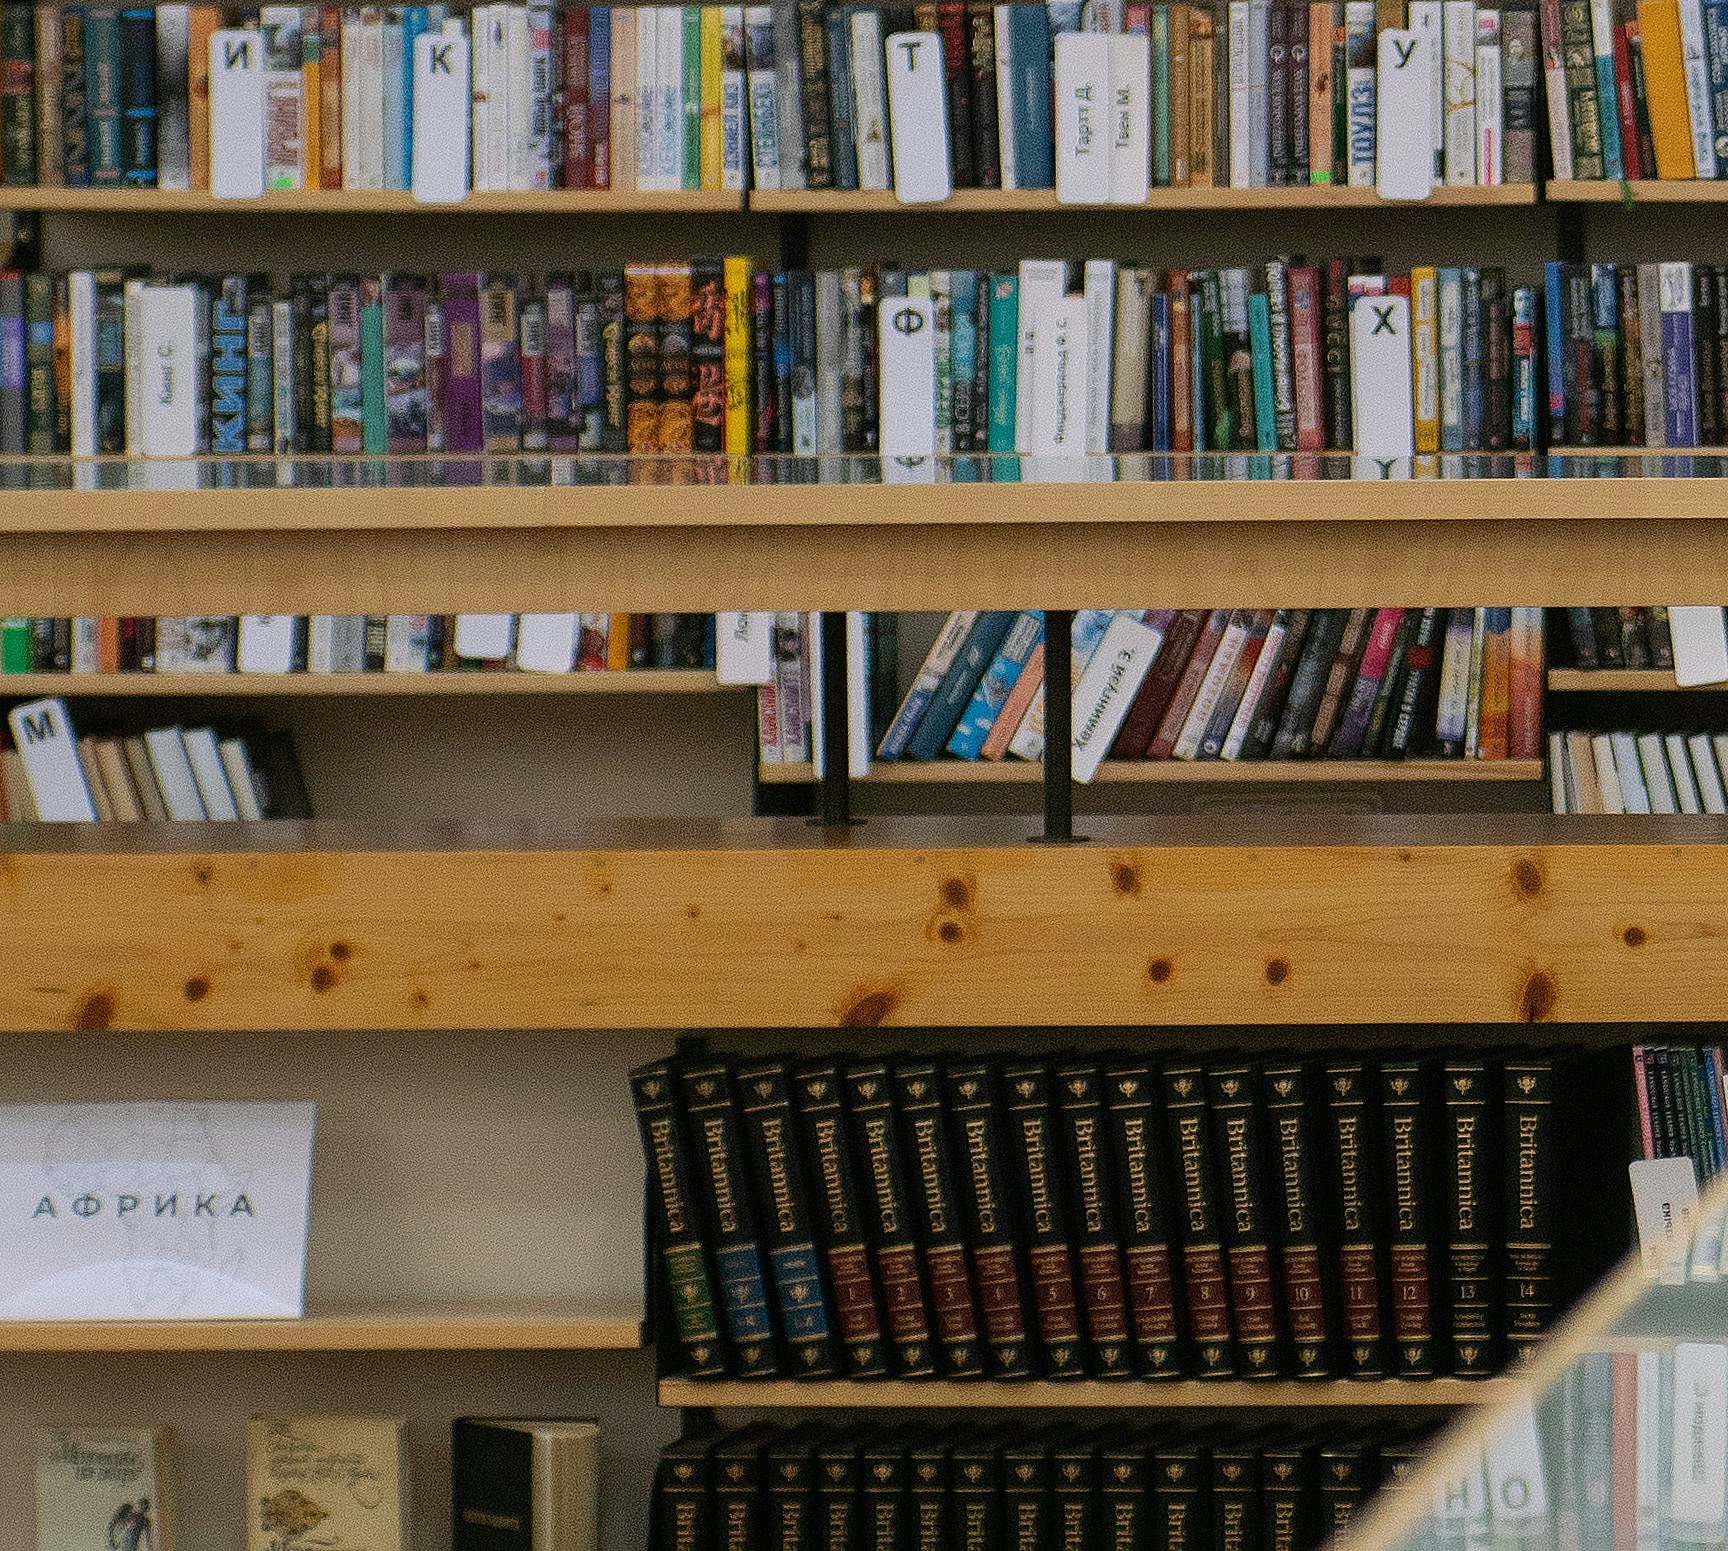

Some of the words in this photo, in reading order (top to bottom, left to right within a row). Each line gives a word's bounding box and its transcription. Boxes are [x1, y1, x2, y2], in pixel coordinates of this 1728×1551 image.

[225, 41, 249, 69] И
[430, 45, 451, 73] К
[899, 40, 922, 72] Т
[1393, 39, 1417, 70] У
[755, 88, 777, 169] СТЕЙНБЕК
[1075, 106, 1094, 156] Тартт
[1114, 110, 1131, 149] Твен
[1350, 87, 1372, 166] ТОУЛЗ
[893, 307, 925, 336] Ф
[1373, 305, 1396, 335] Х
[215, 302, 249, 455] КИНГ
[18, 707, 55, 743] М
[646, 1117, 686, 1234] Britannica
[703, 1117, 738, 1233] Britannica
[761, 1117, 796, 1233] Britannica
[815, 1118, 849, 1233] Britannica
[865, 1118, 899, 1234] Britannica
[914, 1117, 947, 1233] Britannica
[965, 1118, 997, 1234] Britannica
[1022, 1118, 1052, 1233] Britannica
[1074, 1117, 1103, 1233] Britannica
[1124, 1117, 1152, 1233] Britannica
[1179, 1116, 1207, 1232] Britannica
[1226, 1117, 1254, 1233] Britannica
[1279, 1117, 1306, 1233] Britannica
[1338, 1115, 1363, 1231] Britannica
[1393, 1116, 1417, 1231] Britannica
[1456, 1116, 1477, 1231] Britannica
[1519, 1115, 1539, 1229] Britannica
[34, 1193, 254, 1218] АФРИКА
[898, 1286, 910, 1301] 2
[1049, 1286, 1059, 1302] 5
[1097, 1287, 1109, 1301] 6
[1146, 1285, 1157, 1300] 7
[1202, 1285, 1214, 1300] 8
[1246, 1286, 1258, 1301] 9
[1294, 1286, 1314, 1301] 10
[1403, 1286, 1421, 1300] 12
[1459, 1284, 1477, 1299] 13
[1518, 1284, 1535, 1299] 14
